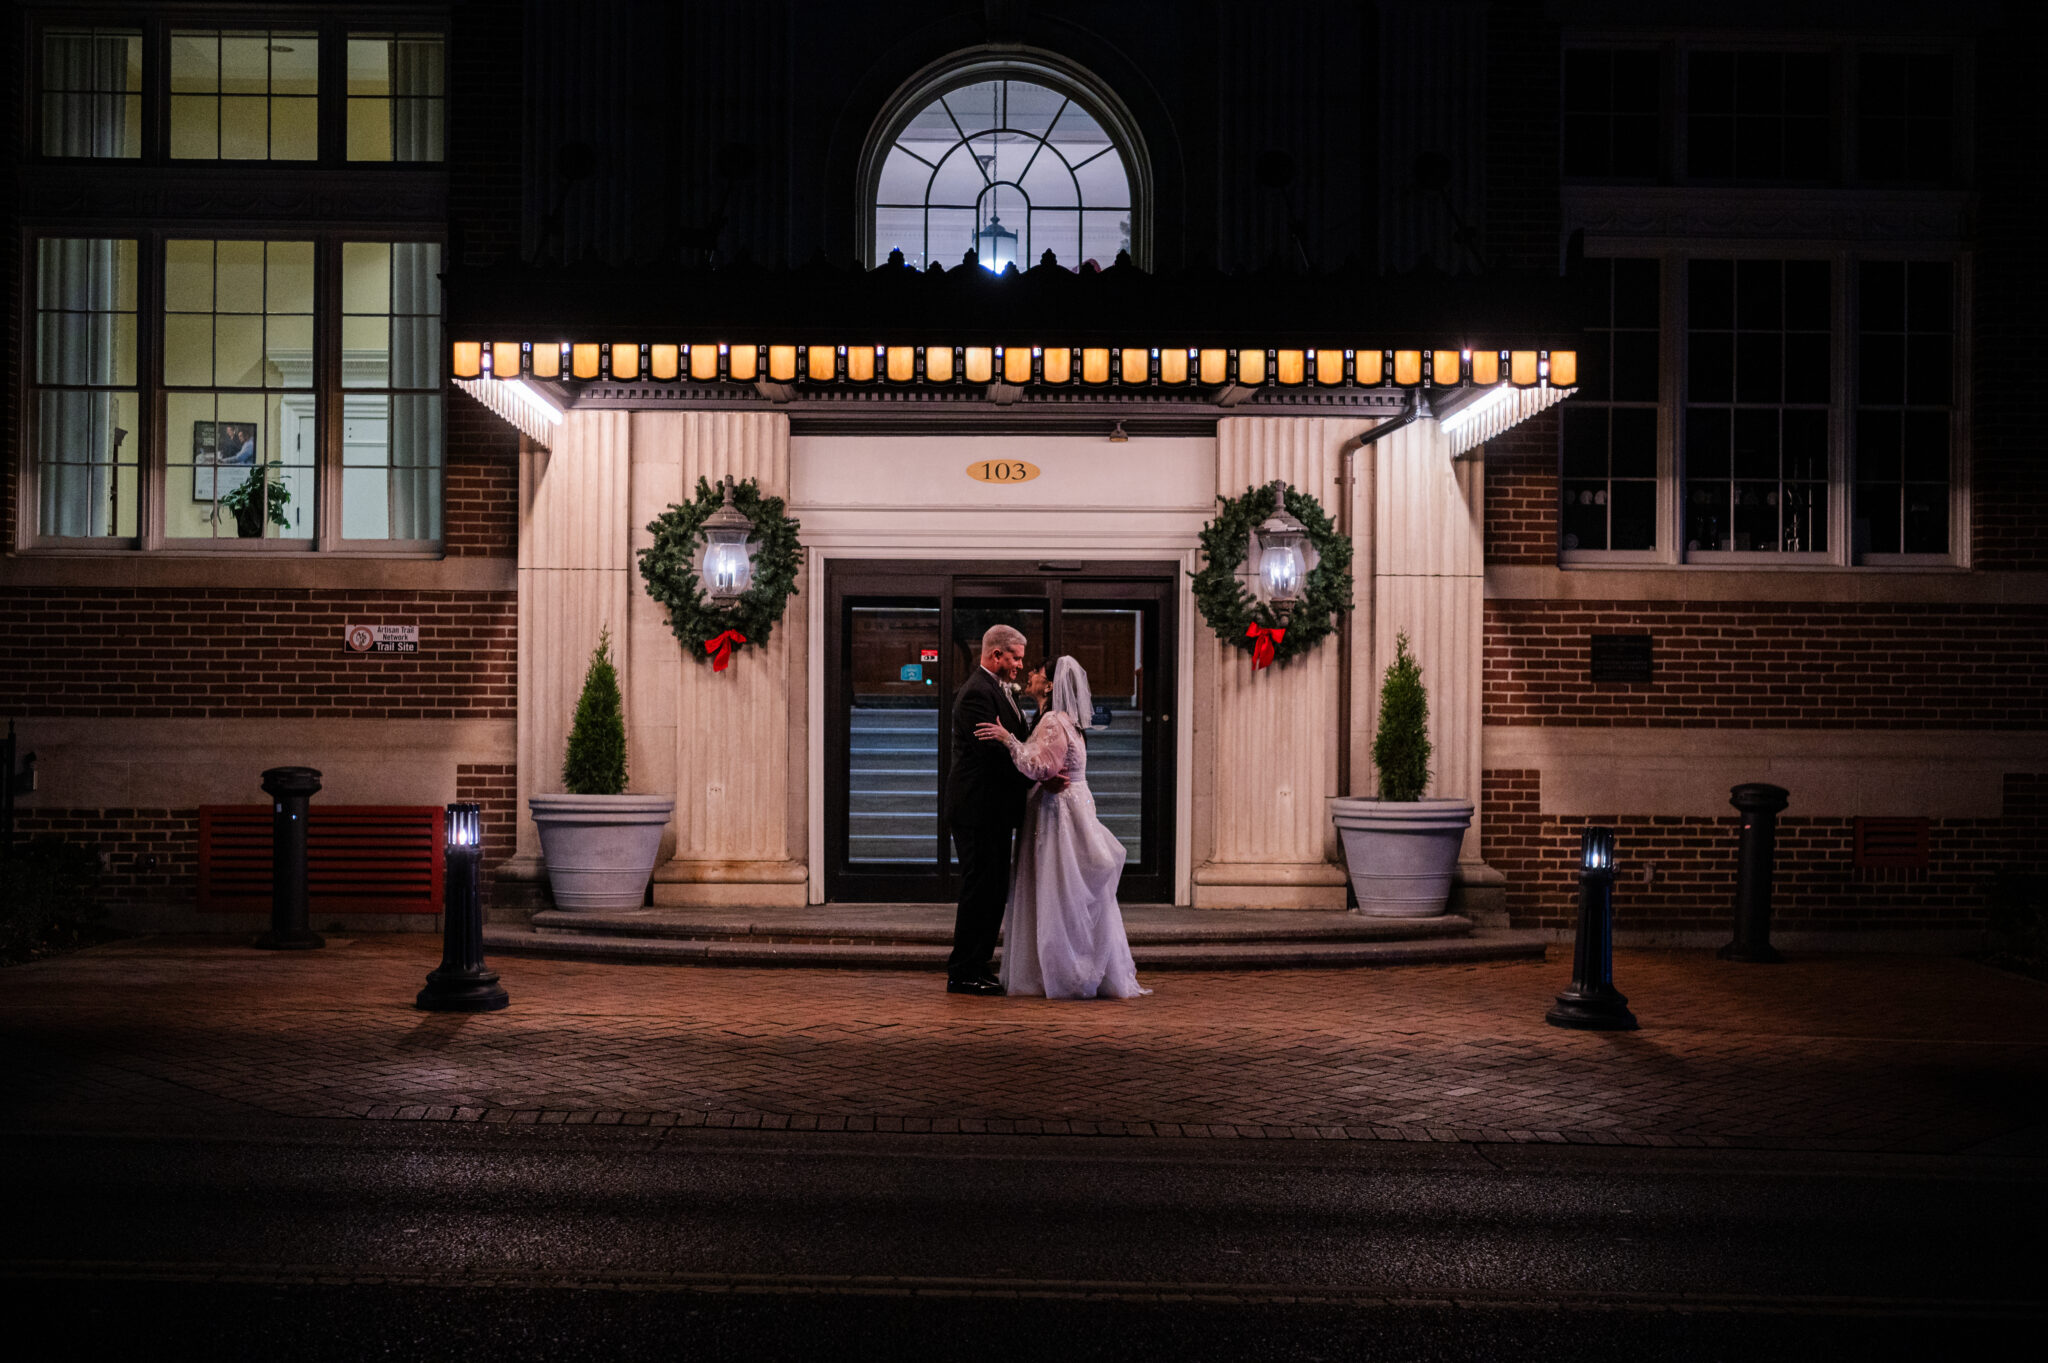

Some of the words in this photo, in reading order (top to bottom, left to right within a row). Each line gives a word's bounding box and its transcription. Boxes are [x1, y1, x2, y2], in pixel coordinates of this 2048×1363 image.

[982, 462, 1027, 480] 103
[376, 642, 395, 651] Trail
[397, 642, 414, 651] Site
